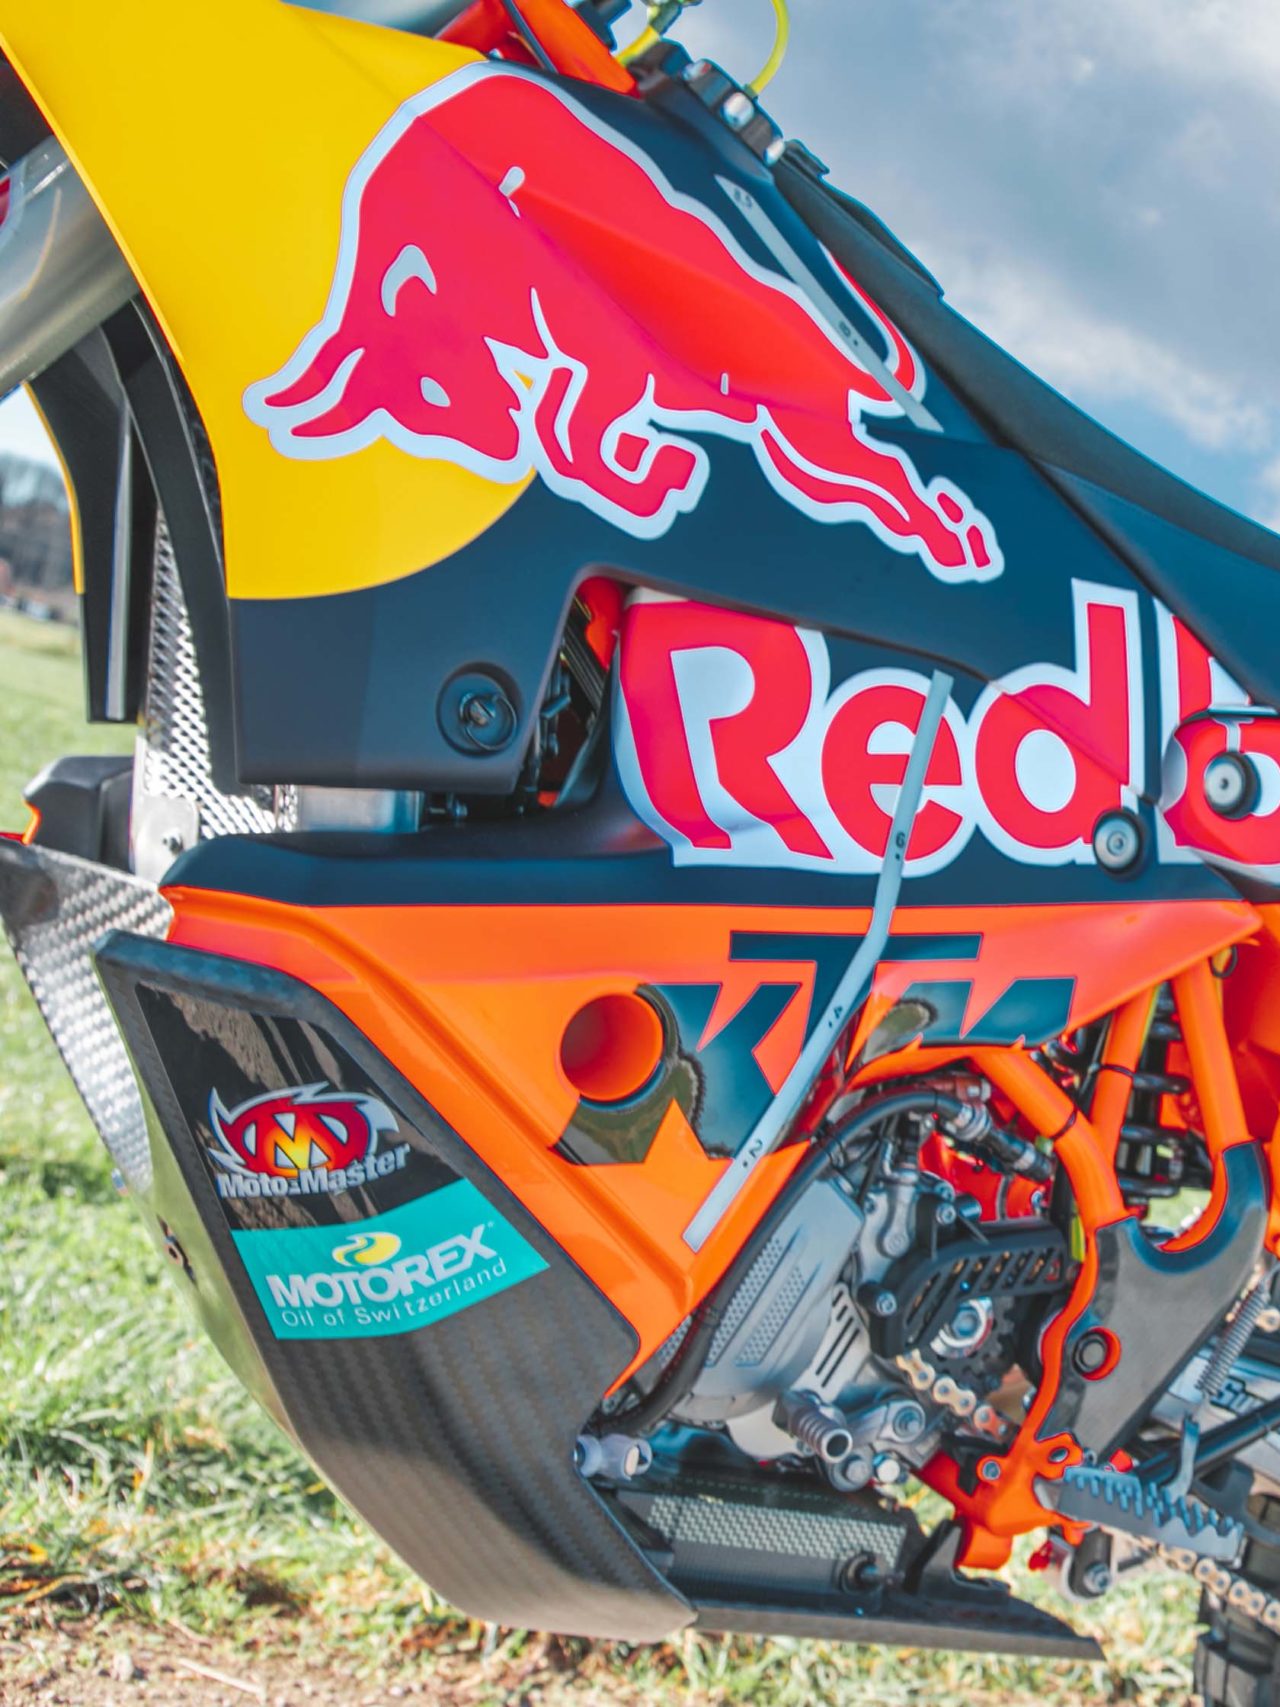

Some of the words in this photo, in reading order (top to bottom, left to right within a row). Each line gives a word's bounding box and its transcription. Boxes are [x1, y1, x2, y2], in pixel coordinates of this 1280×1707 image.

[611, 580, 1143, 877] Red
[555, 930, 1078, 1164] KTM
[265, 1223, 498, 1309] MOTOREX
[281, 1309, 315, 1328] Oil
[323, 1307, 346, 1327] of
[354, 1257, 507, 1326] Switzerland
